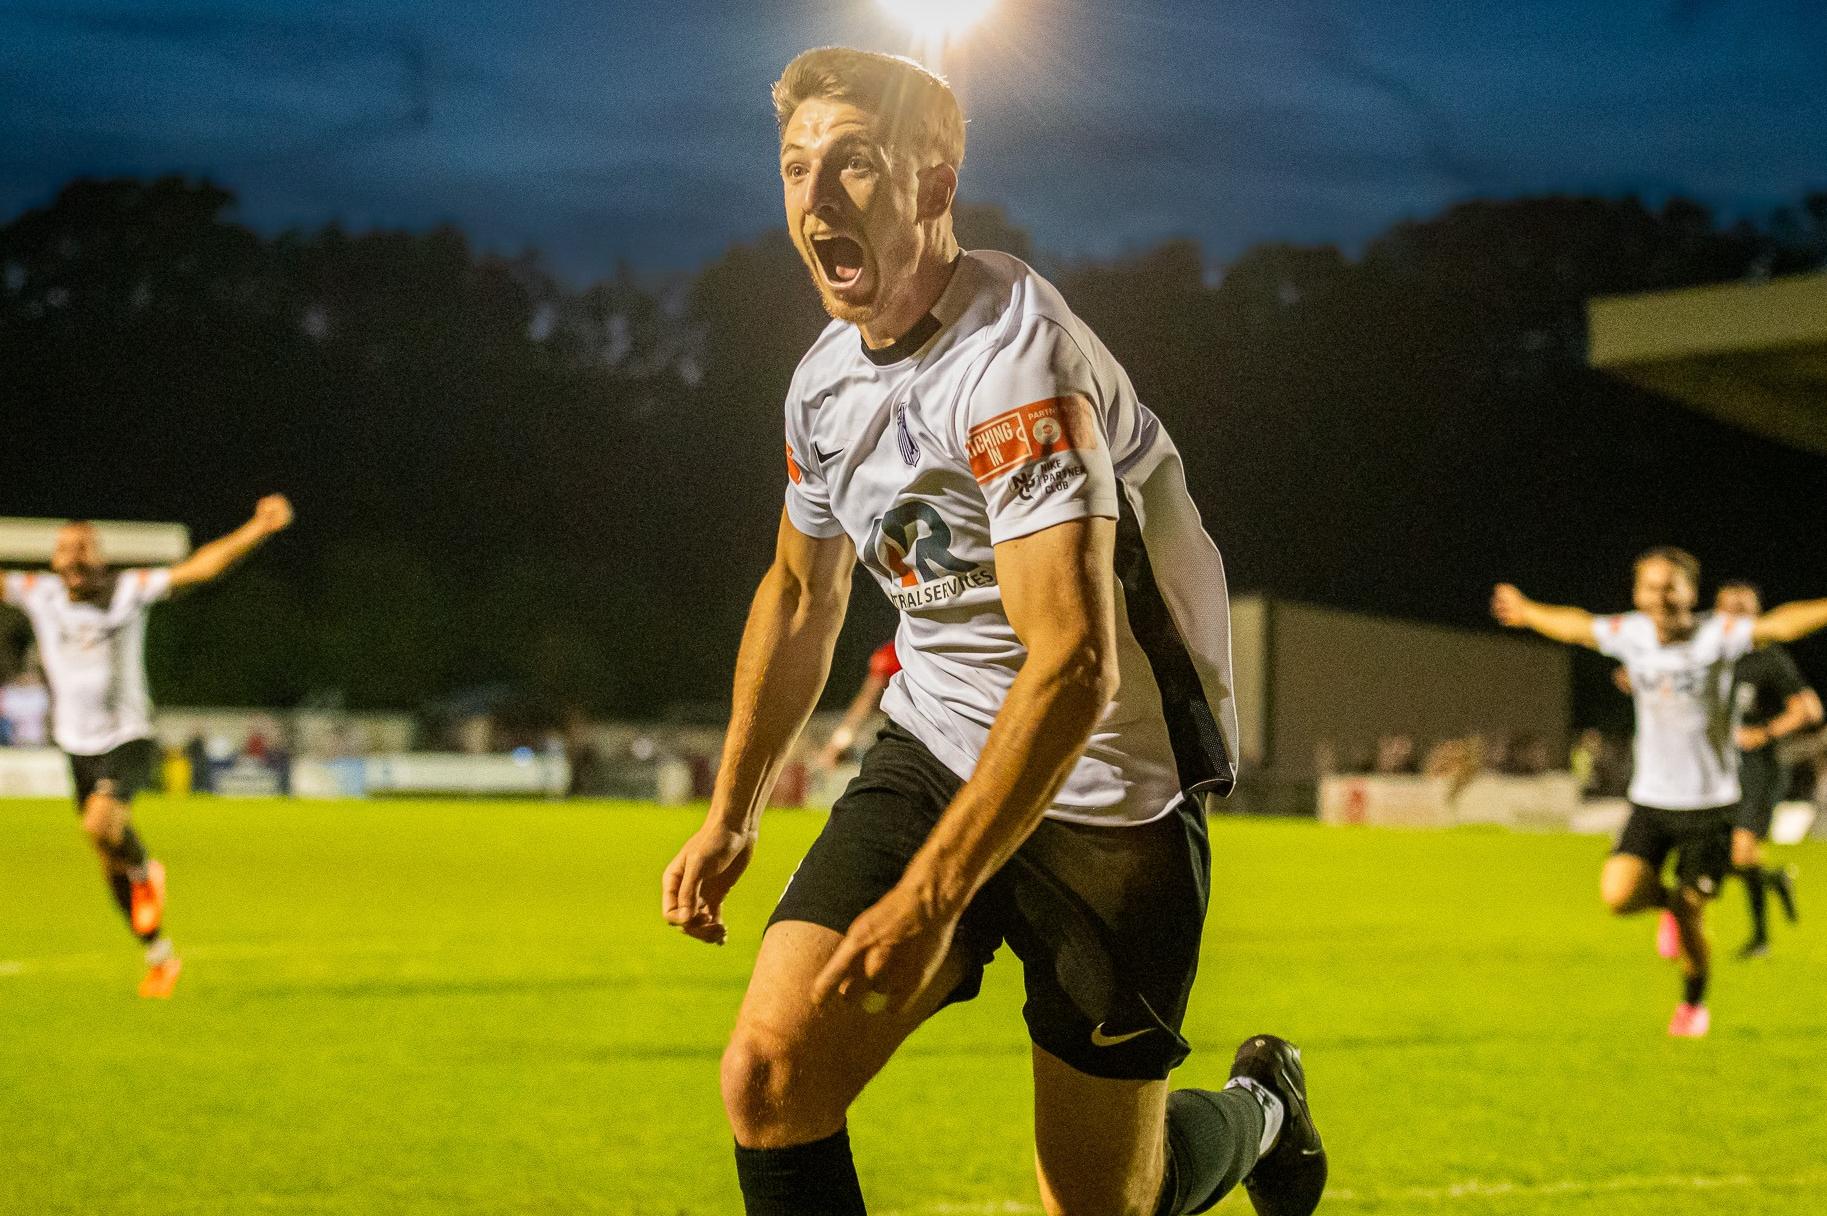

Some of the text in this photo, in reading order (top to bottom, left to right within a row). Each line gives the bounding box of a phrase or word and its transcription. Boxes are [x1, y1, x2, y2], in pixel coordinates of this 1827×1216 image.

[985, 446, 1005, 467] IN
[1040, 459, 1062, 473] NIKE
[1045, 480, 1070, 495] CLUB
[924, 570, 994, 603] SERVICES
